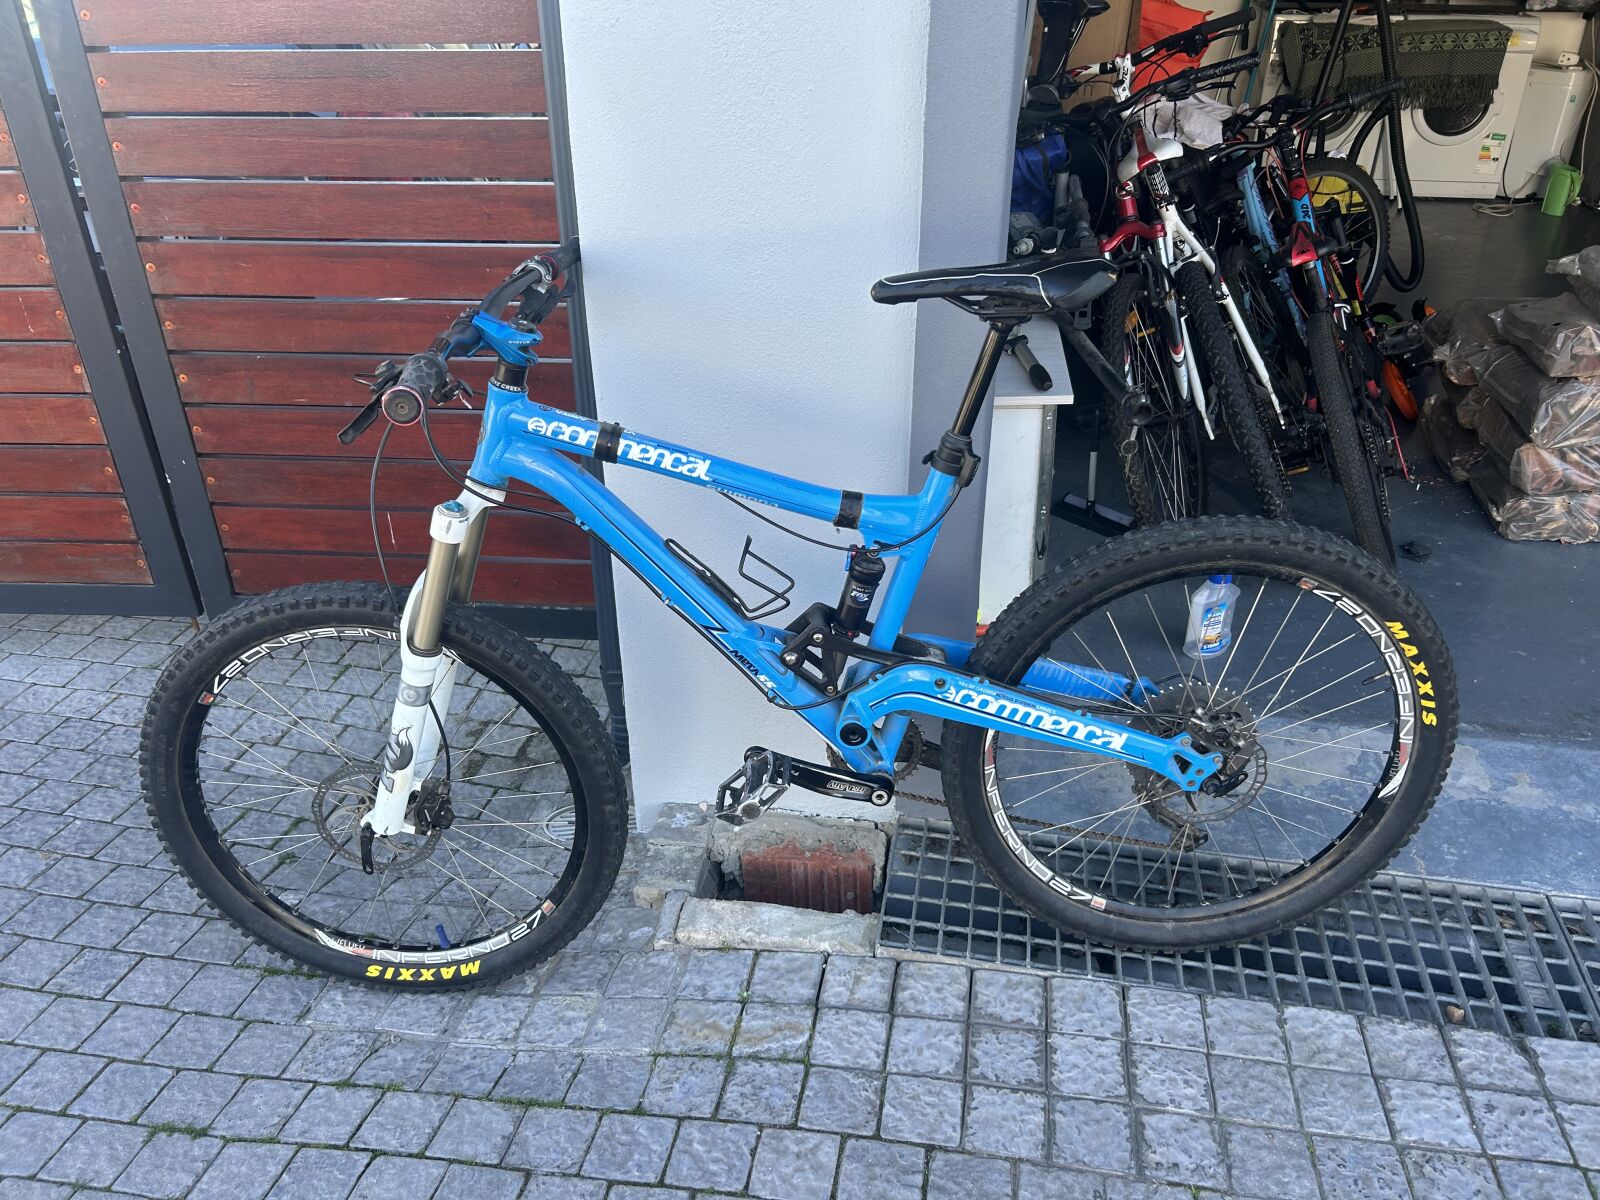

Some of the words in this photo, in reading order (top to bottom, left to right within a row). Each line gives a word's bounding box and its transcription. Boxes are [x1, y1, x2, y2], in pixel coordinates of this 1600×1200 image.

[1384, 620, 1438, 727] MAXXIS
[953, 688, 1129, 752] commencal
[365, 959, 482, 981] MAXXIS
